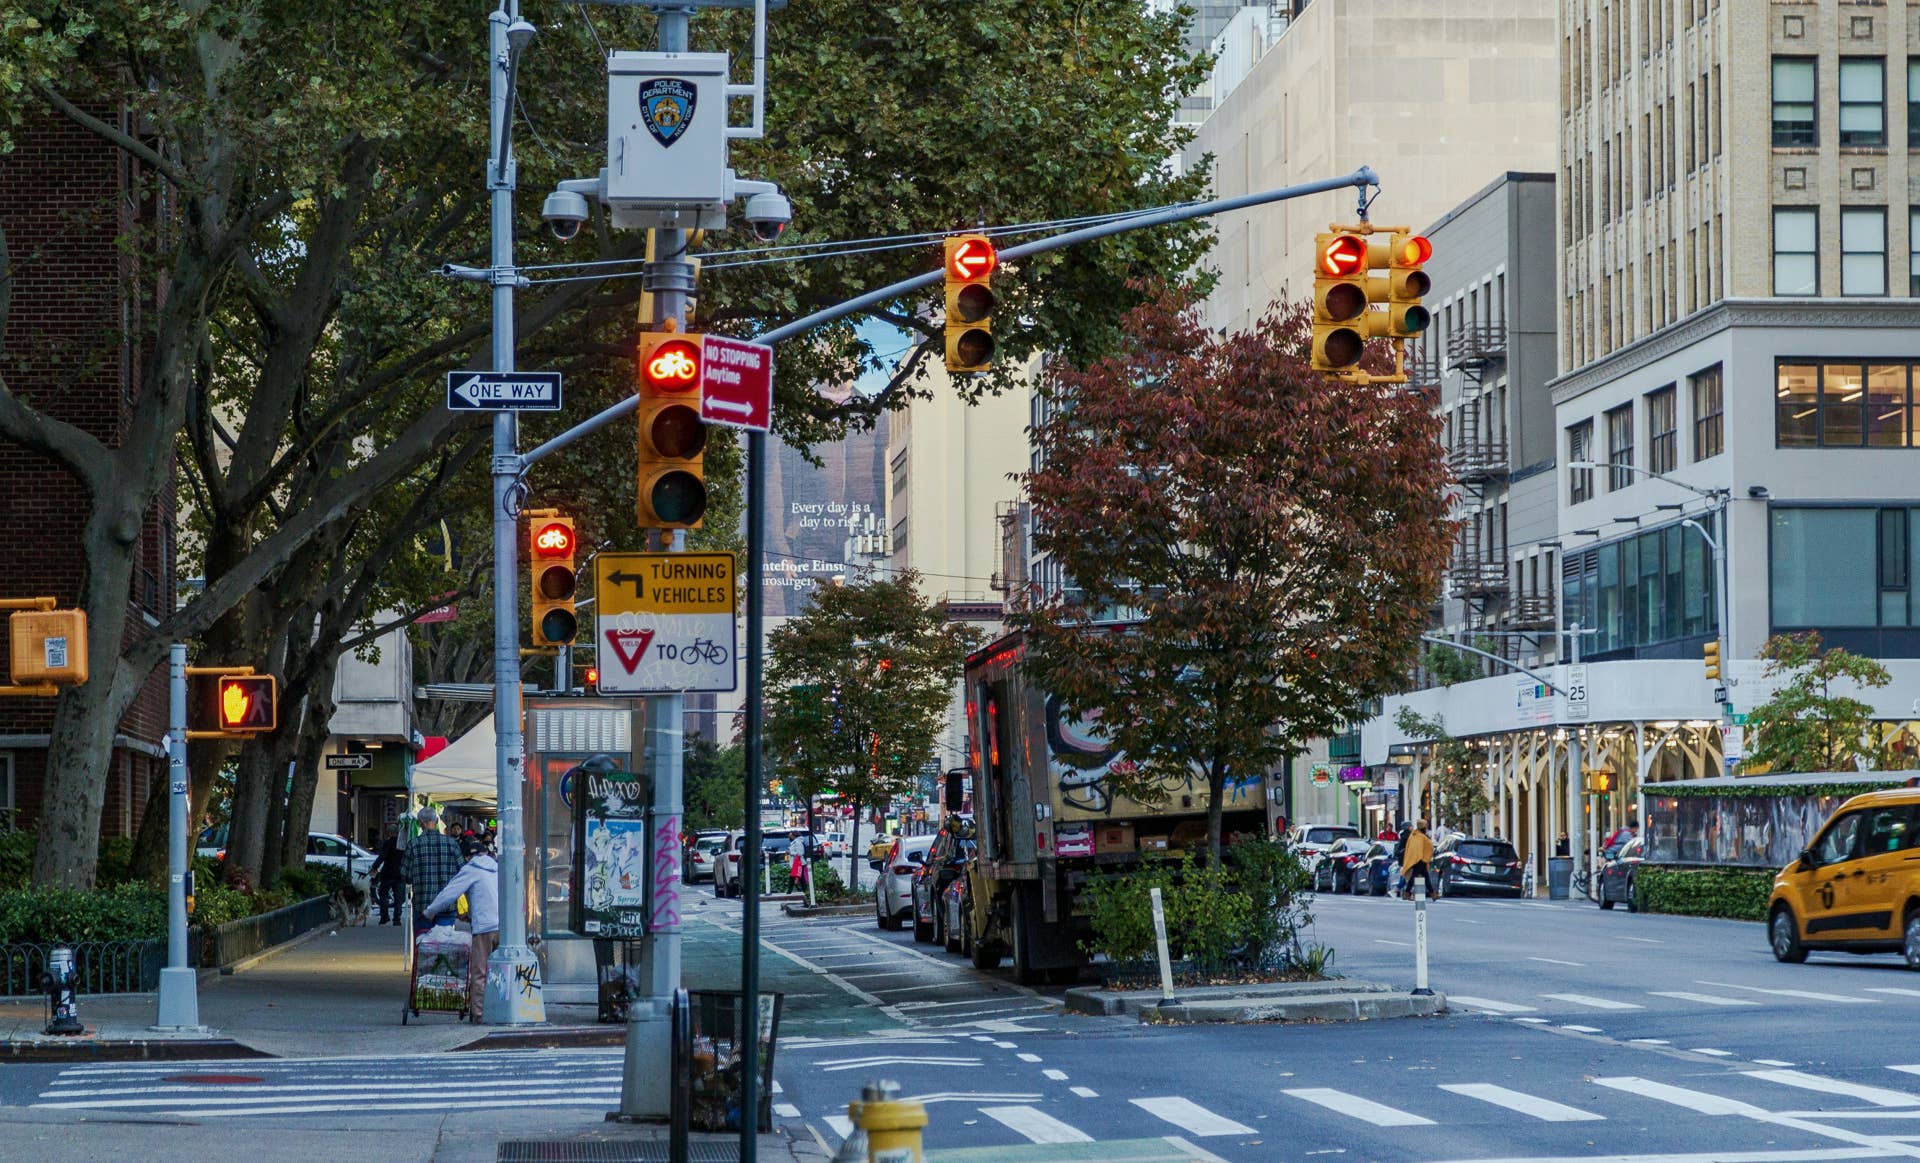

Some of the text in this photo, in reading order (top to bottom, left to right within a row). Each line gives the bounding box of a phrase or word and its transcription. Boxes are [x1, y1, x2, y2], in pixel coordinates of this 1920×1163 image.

[654, 80, 682, 89] POLICE
[642, 88, 693, 100] DEPARTMENT
[642, 105, 658, 135] CITY OF
[675, 105, 694, 137] NEW YORK
[705, 346, 761, 369] NO STOPPING
[705, 364, 741, 385] Anytime
[469, 384, 545, 398] ONE WAY
[791, 501, 871, 515] Every day is a
[799, 516, 822, 530] day
[823, 517, 835, 528] to
[650, 563, 726, 580] TURNING
[762, 559, 809, 573] ntefiore
[652, 587, 725, 603] VEHICLES
[656, 644, 677, 660] TO
[1570, 686, 1586, 701] 25
